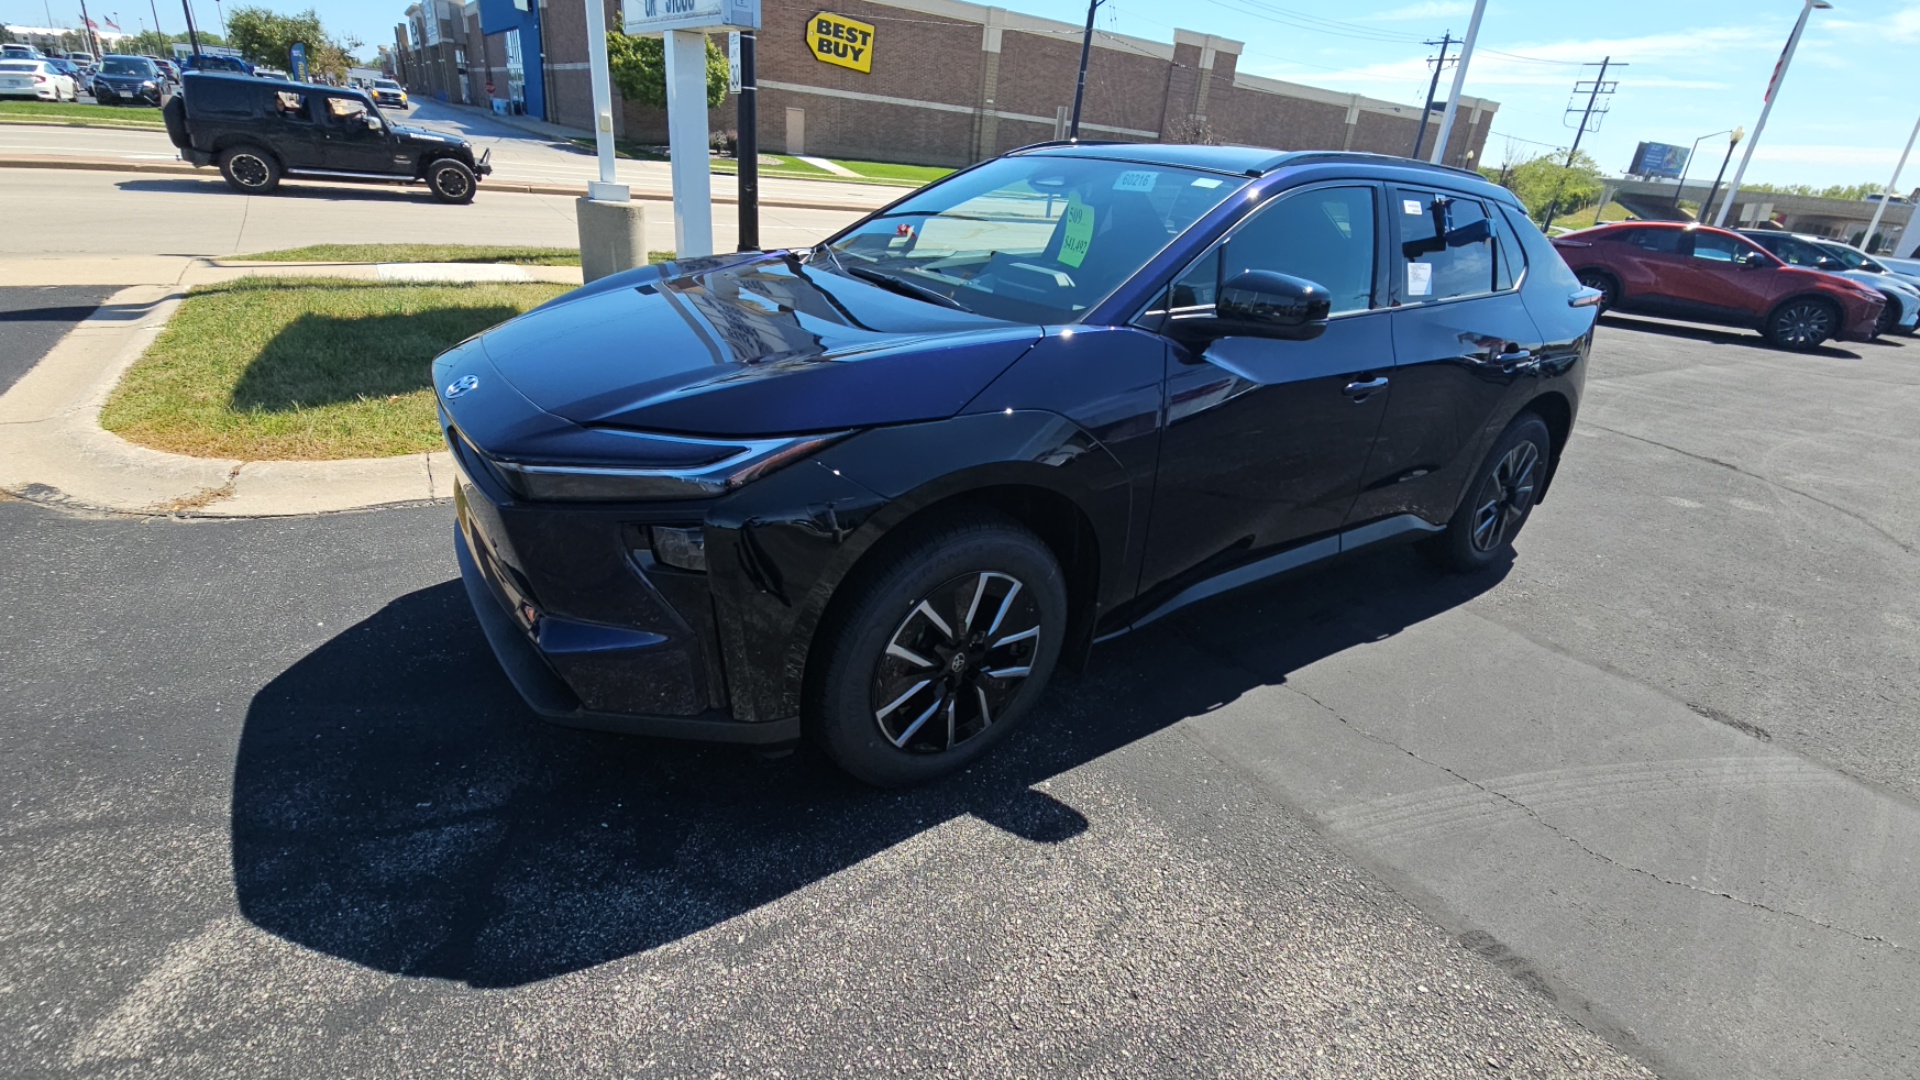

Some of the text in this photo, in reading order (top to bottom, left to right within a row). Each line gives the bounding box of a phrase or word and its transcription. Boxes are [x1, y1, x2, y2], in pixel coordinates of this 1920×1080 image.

[816, 18, 871, 46] BEST
[817, 37, 864, 62] BUY
[1122, 172, 1149, 186] 60216
